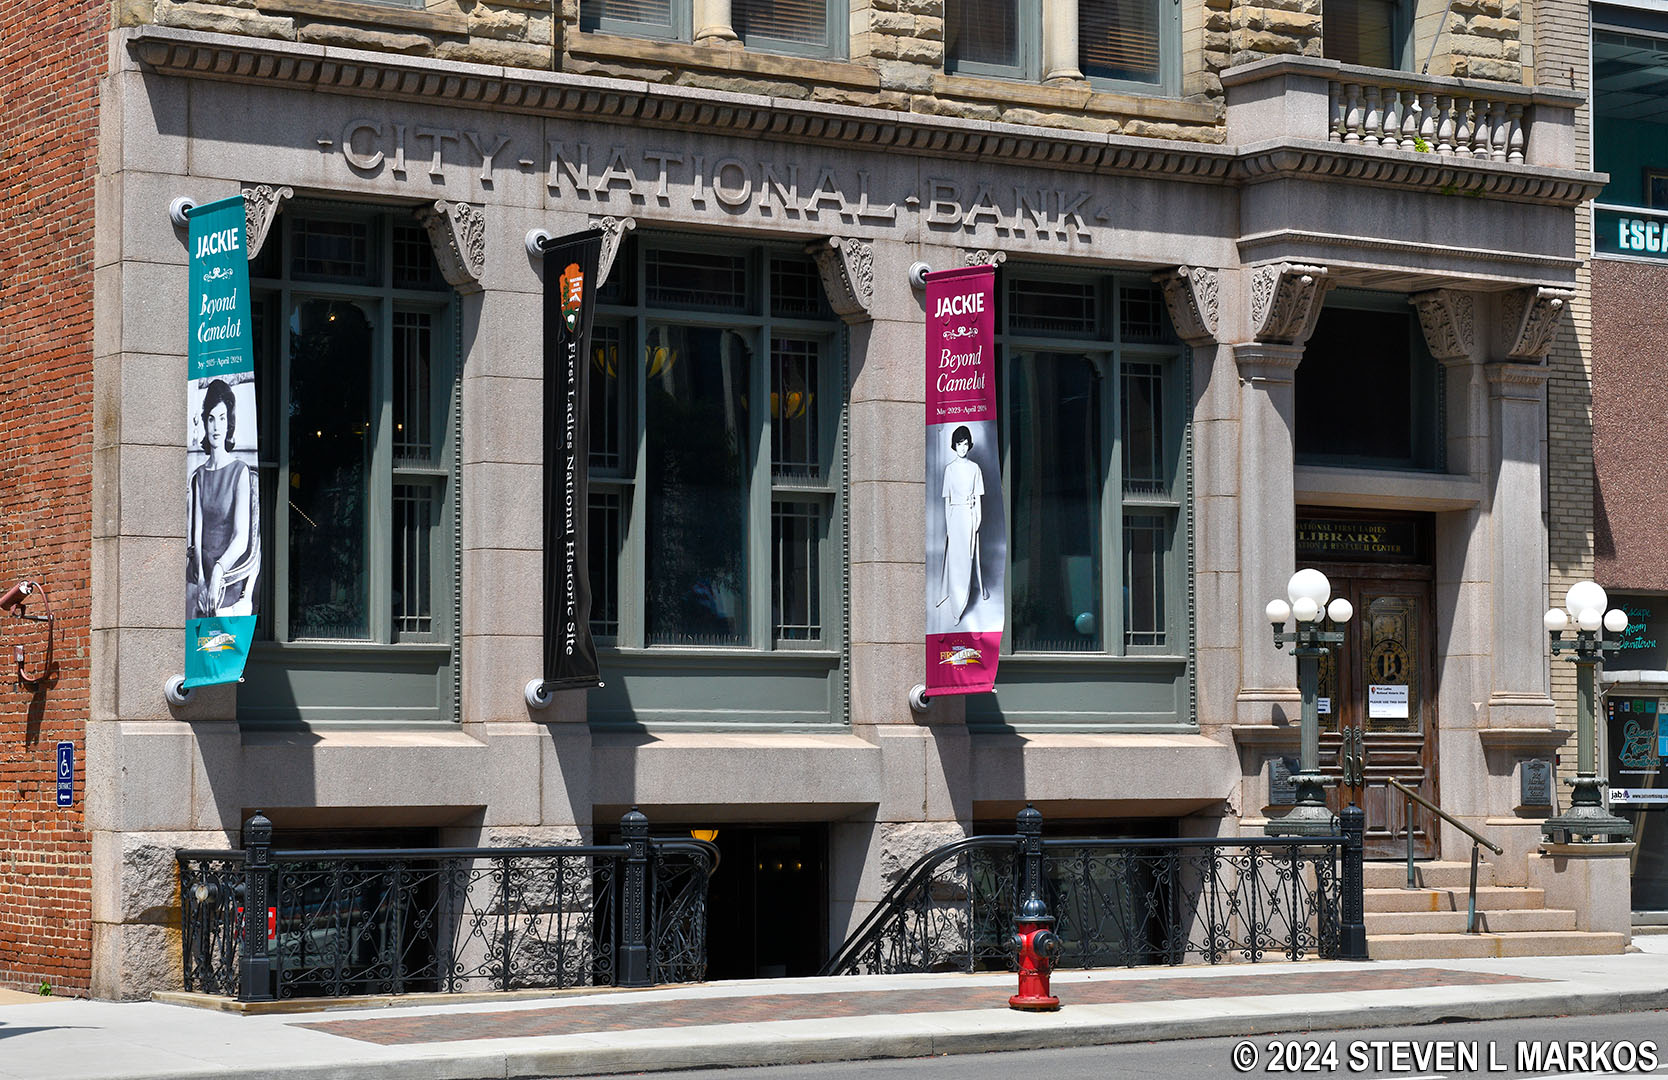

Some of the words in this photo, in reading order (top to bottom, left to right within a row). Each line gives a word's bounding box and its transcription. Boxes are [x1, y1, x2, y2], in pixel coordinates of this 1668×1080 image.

[342, 119, 510, 181] CITY
[547, 139, 896, 218] NATIONAL
[927, 176, 1093, 236] BANK
[195, 227, 240, 259] JACKIE
[199, 288, 237, 320] Beyond
[934, 292, 985, 318] JACKIE
[197, 317, 242, 343] Camelot
[568, 342, 576, 384] First
[938, 345, 982, 373] Beyond
[936, 370, 985, 393] Camelot
[566, 390, 576, 449] Ladies
[566, 454, 575, 535] National
[1297, 531, 1383, 543] LIBRARY
[1371, 544, 1401, 552] CENTER
[566, 541, 575, 616] Historic
[1623, 603, 1651, 622] Escape
[566, 622, 576, 656] Site
[1619, 634, 1656, 649] Downtown
[1625, 623, 1647, 636] Room
[1611, 790, 1623, 800] jab
